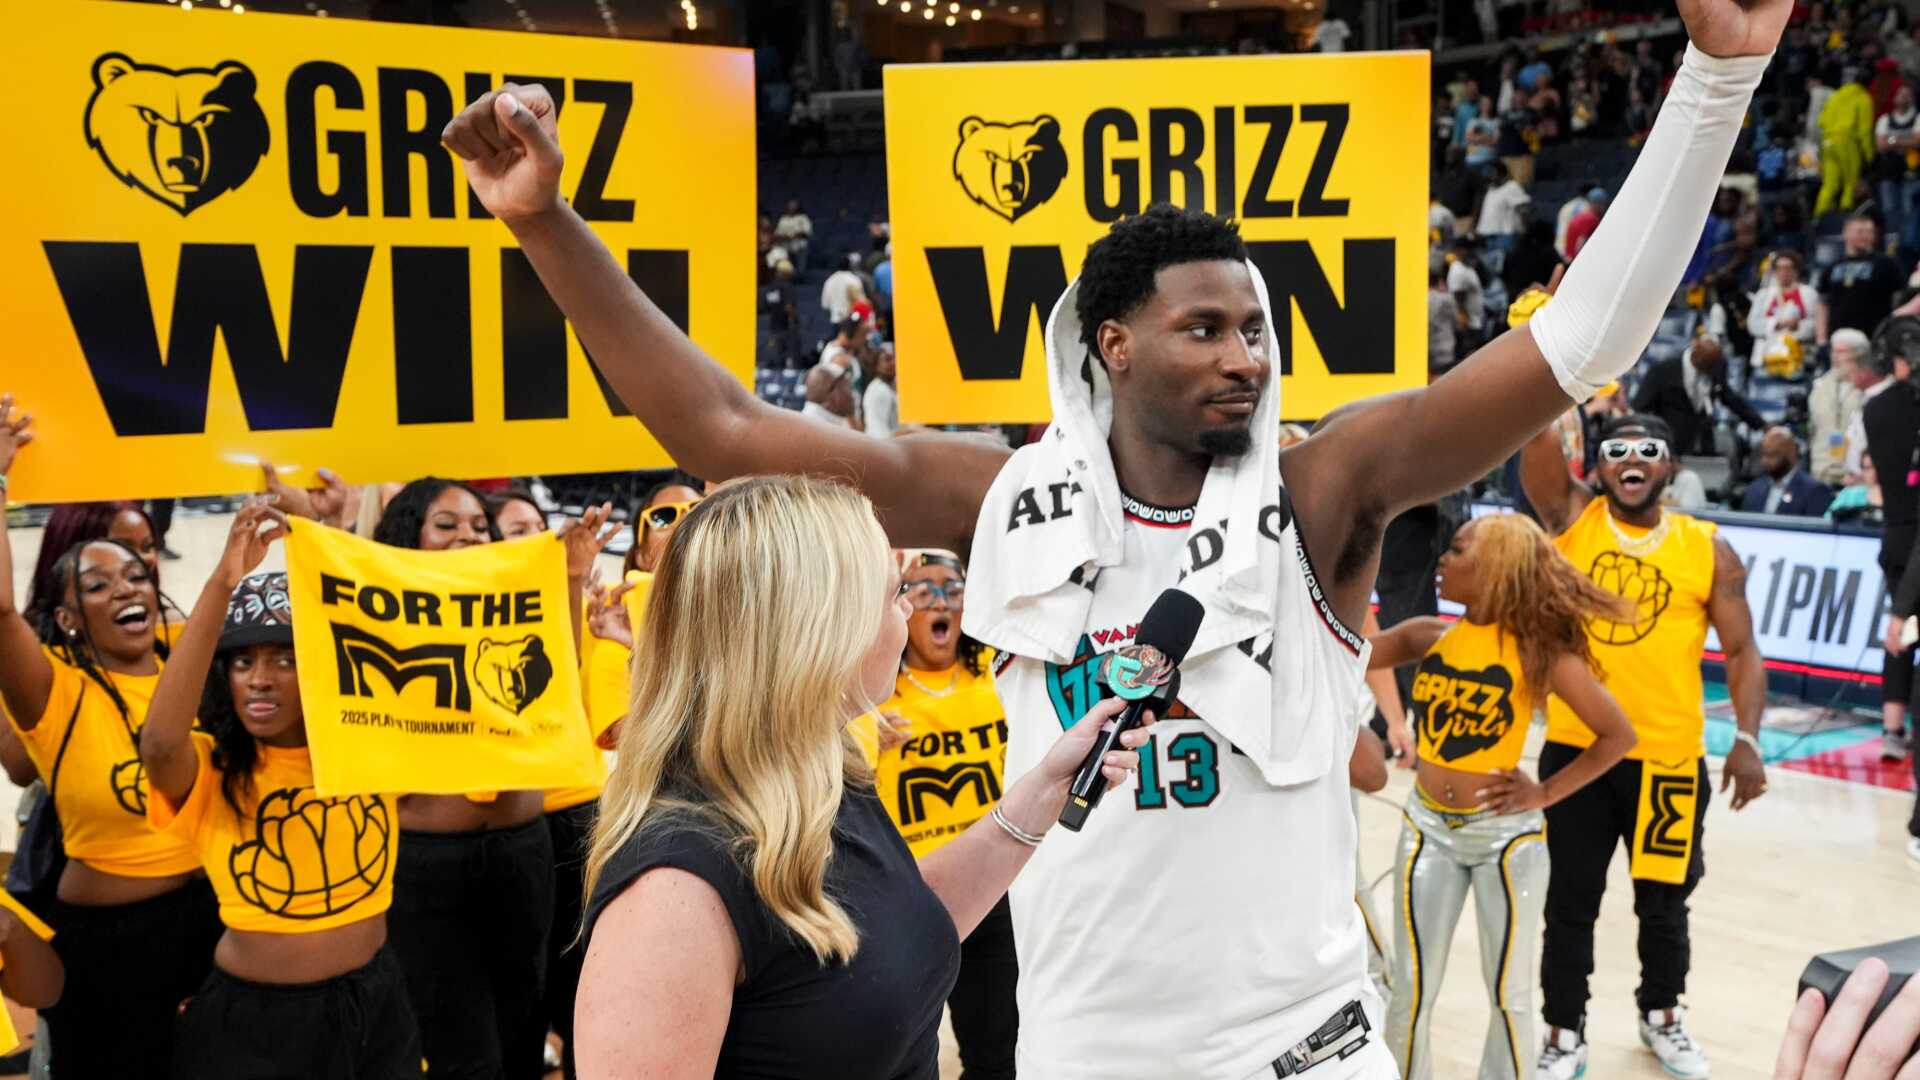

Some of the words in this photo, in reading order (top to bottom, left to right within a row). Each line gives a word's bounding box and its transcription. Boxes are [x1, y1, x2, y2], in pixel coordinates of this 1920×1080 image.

[1082, 103, 1350, 223] GRIZZ
[321, 572, 442, 626] FOR
[449, 590, 543, 627] THE
[1760, 558, 1863, 646] 1PM
[1412, 672, 1505, 716] GRIZZ
[341, 710, 369, 726] 2025
[406, 719, 475, 735] TOURNAMENT
[901, 731, 966, 760] FOR
[1135, 732, 1221, 811] 13
